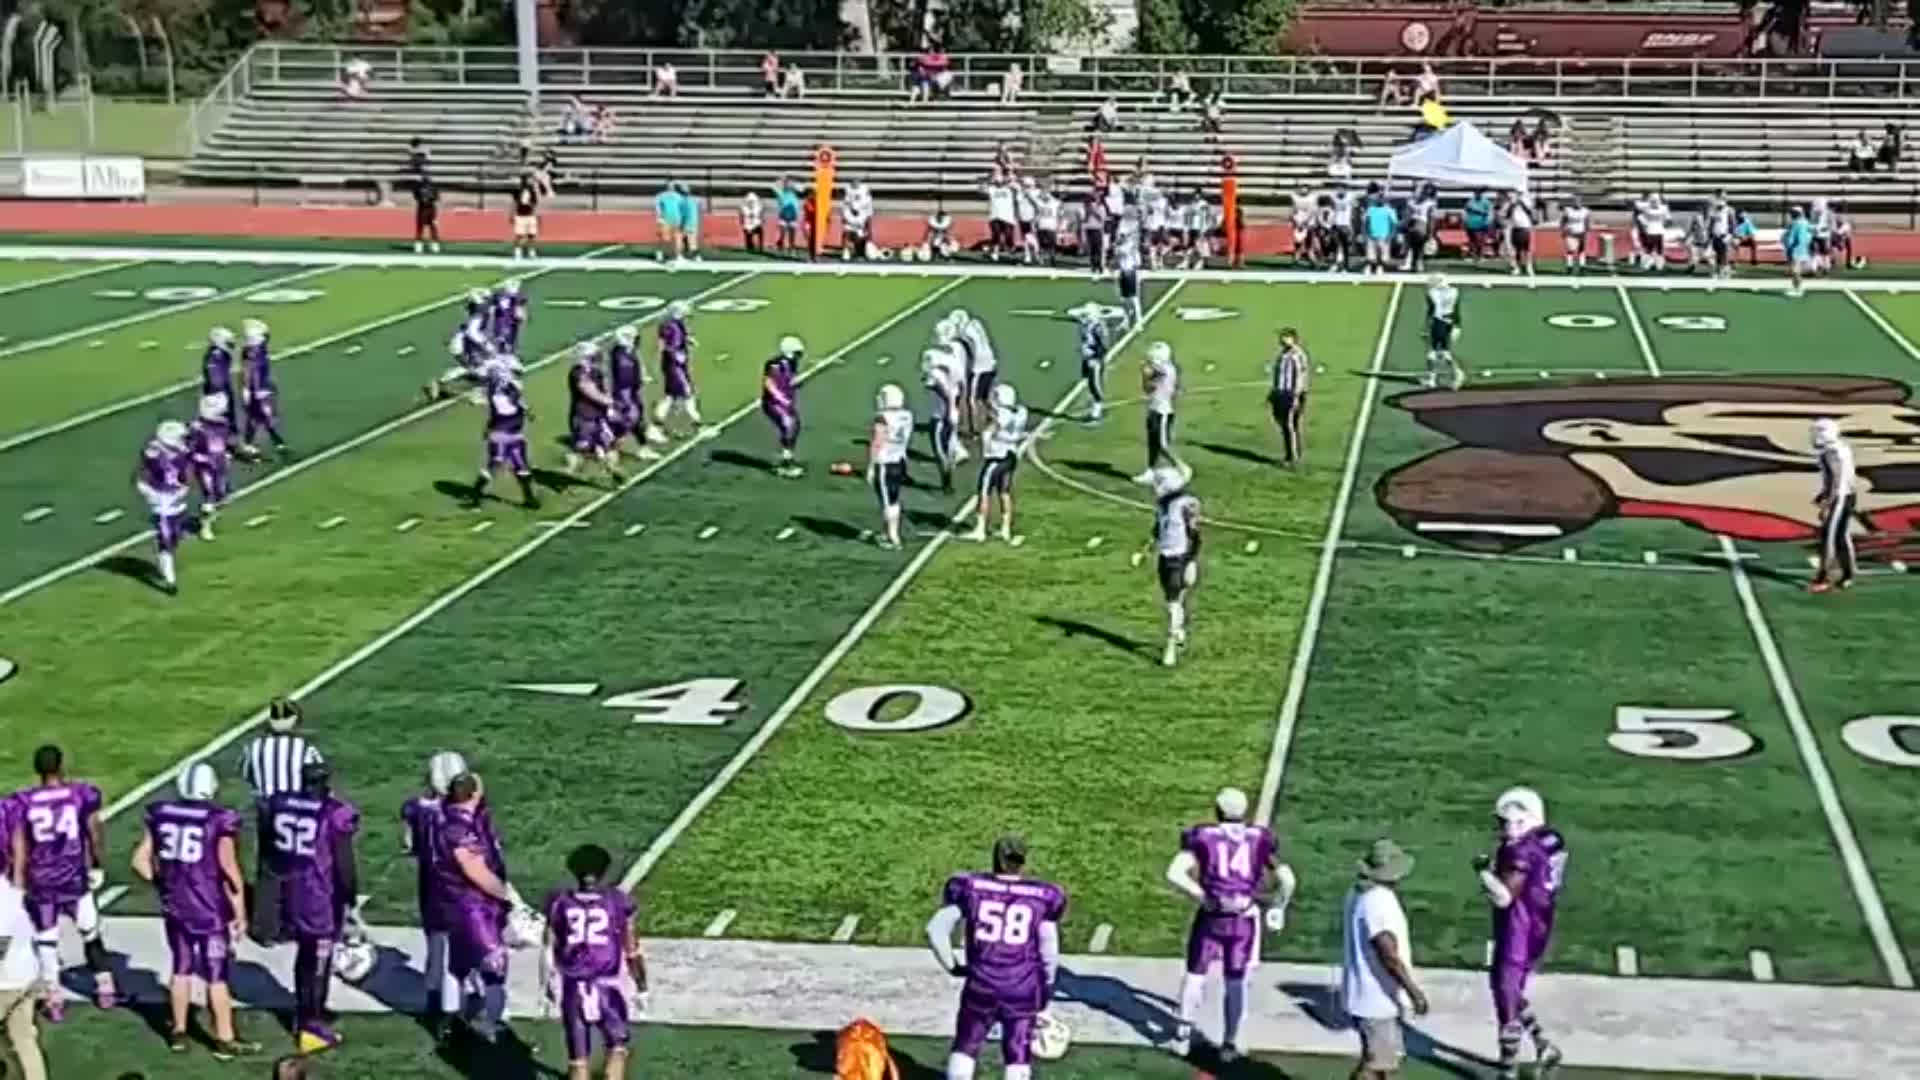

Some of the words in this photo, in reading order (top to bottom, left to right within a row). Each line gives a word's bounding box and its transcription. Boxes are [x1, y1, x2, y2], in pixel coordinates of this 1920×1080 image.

[28, 806, 79, 842] 24
[159, 823, 204, 863] 36
[274, 813, 318, 855] 52
[1217, 841, 1251, 878] 14
[566, 908, 609, 945] 32
[975, 900, 1033, 945] 58
